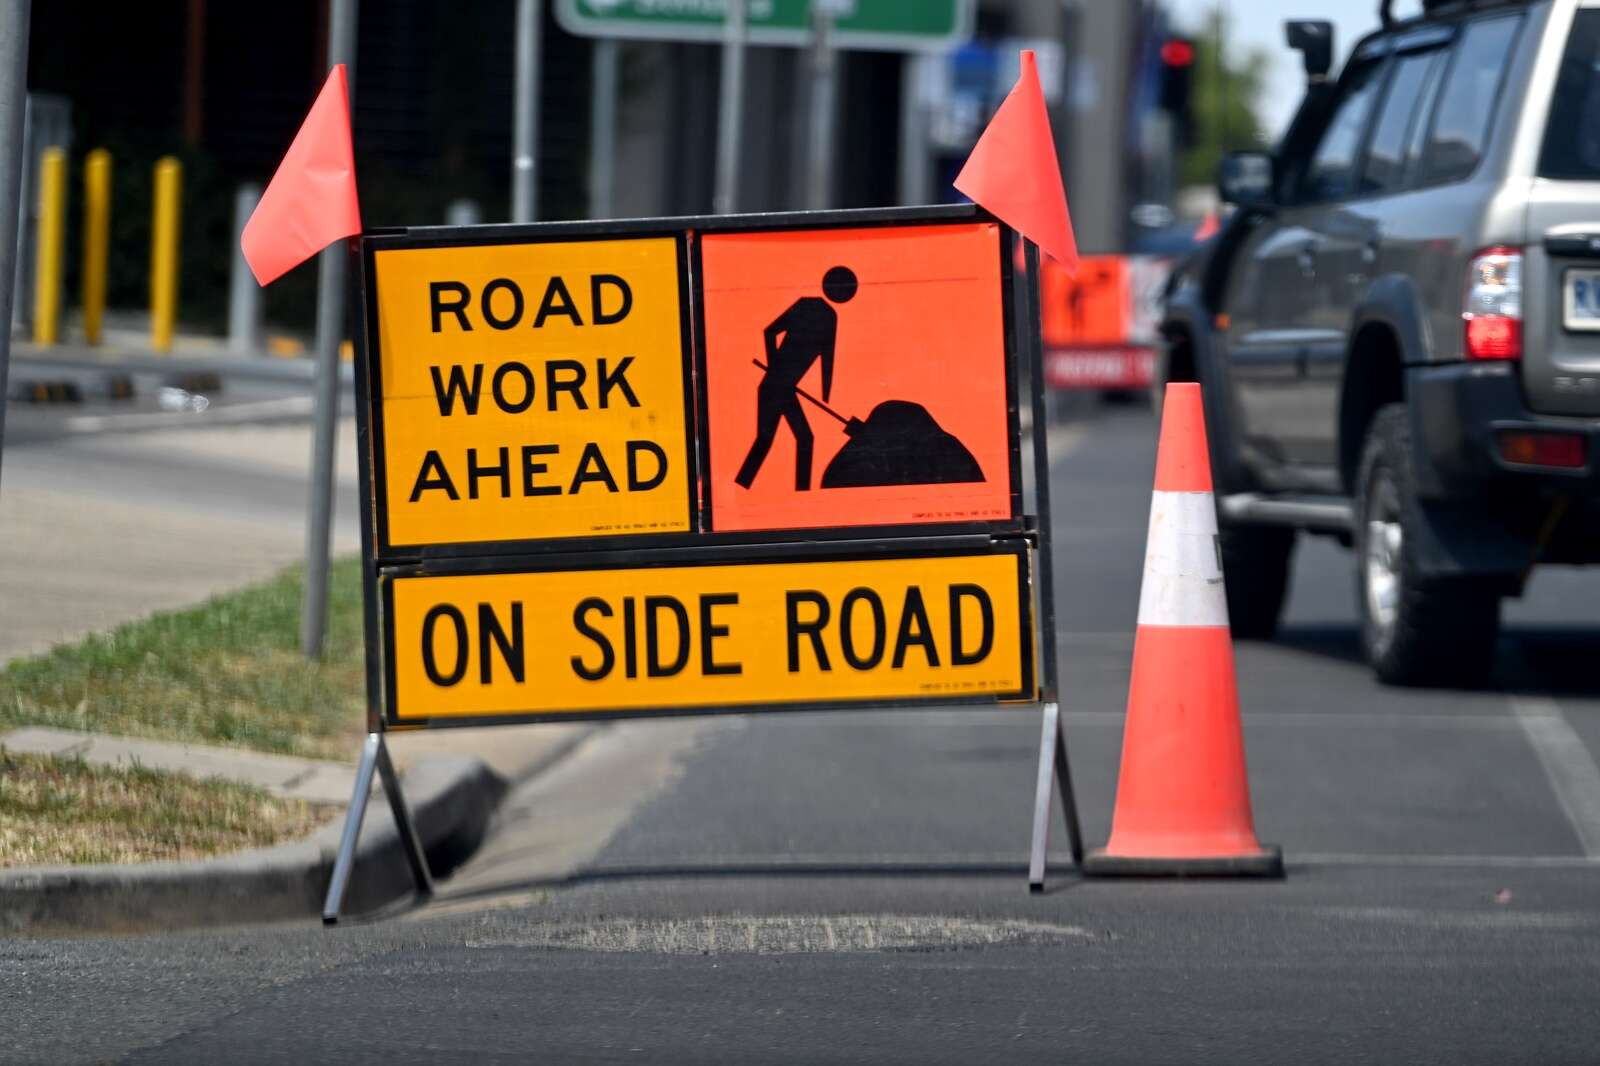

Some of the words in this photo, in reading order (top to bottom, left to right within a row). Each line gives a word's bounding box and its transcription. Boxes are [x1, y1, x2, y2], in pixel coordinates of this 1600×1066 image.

[430, 274, 632, 332] ROAD
[431, 357, 640, 416] WORK
[410, 441, 667, 502] AHEAD
[422, 602, 524, 687] ON
[571, 593, 742, 681] SIDE
[786, 584, 994, 672] ROAD
